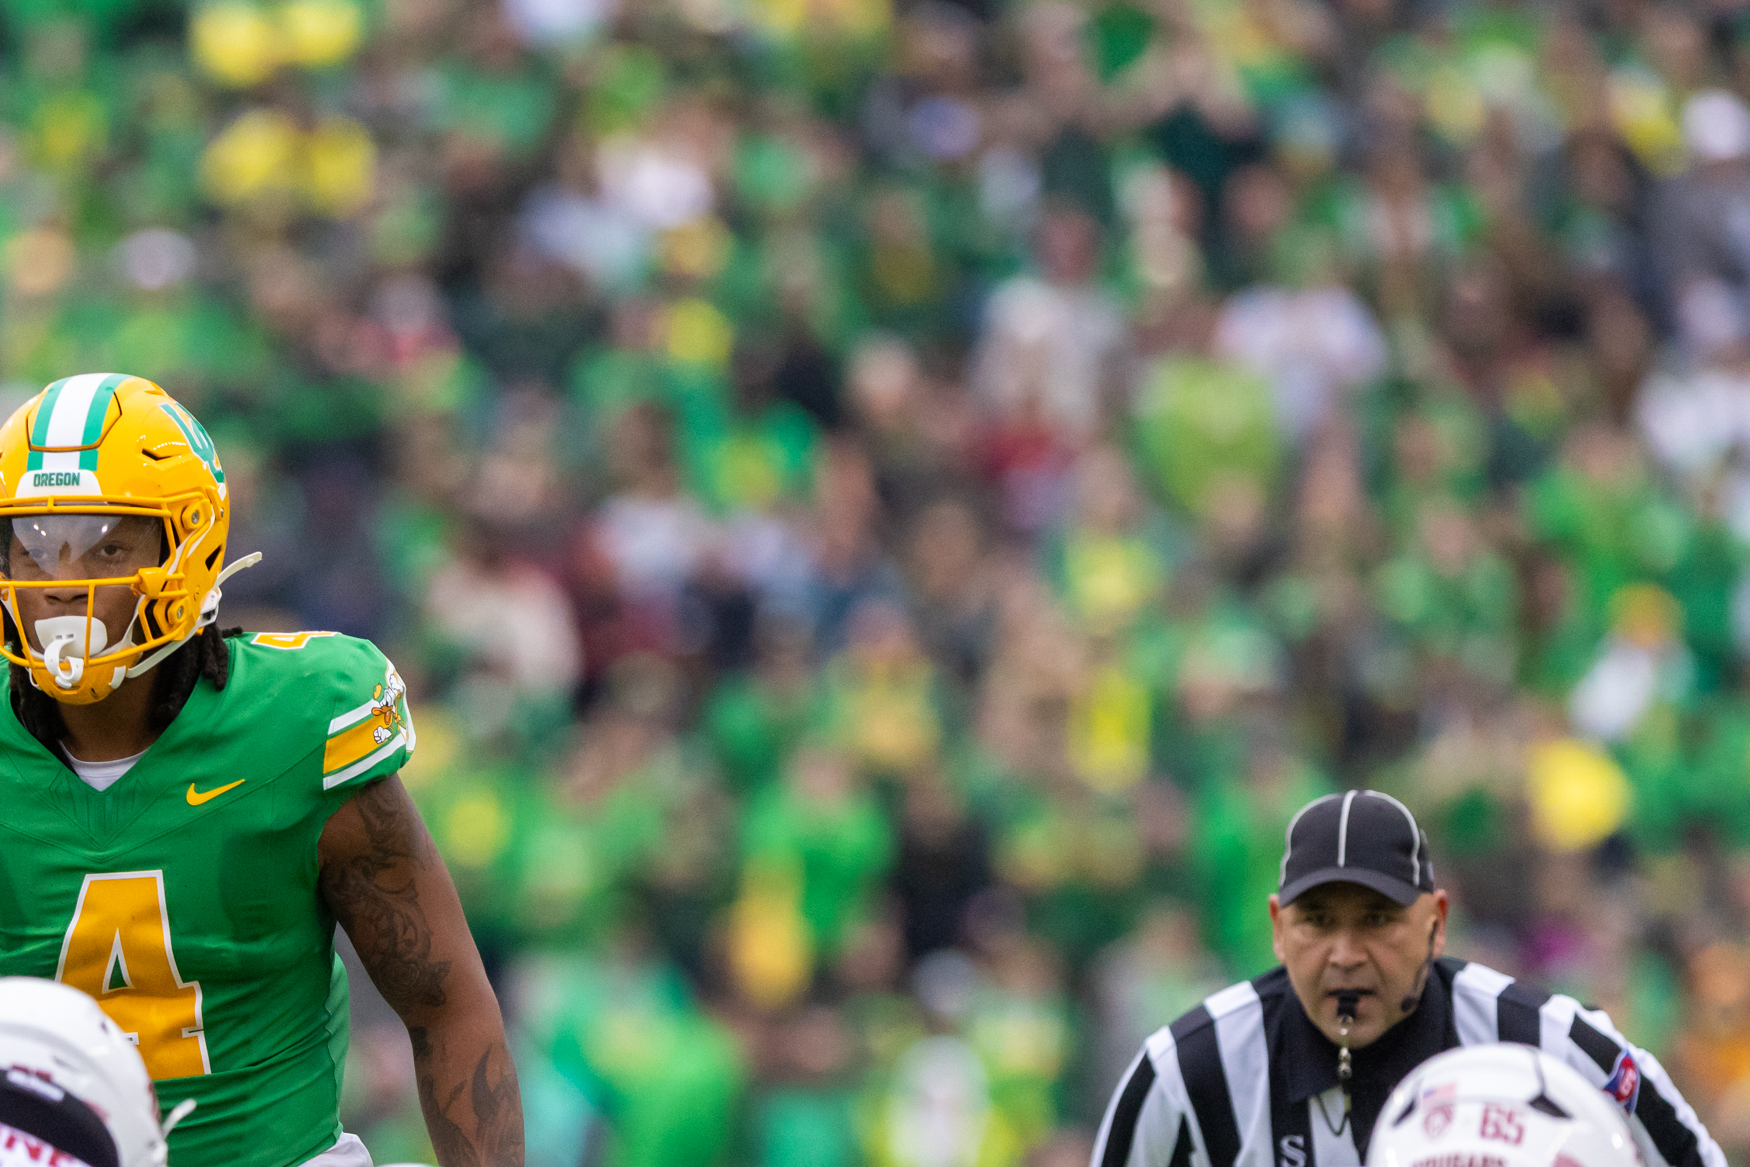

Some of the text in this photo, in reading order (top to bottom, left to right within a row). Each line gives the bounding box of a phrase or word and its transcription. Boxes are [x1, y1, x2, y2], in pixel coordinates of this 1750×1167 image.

[33, 471, 81, 487] OREGON
[54, 868, 212, 1081] 4
[1479, 1103, 1525, 1146] 65
